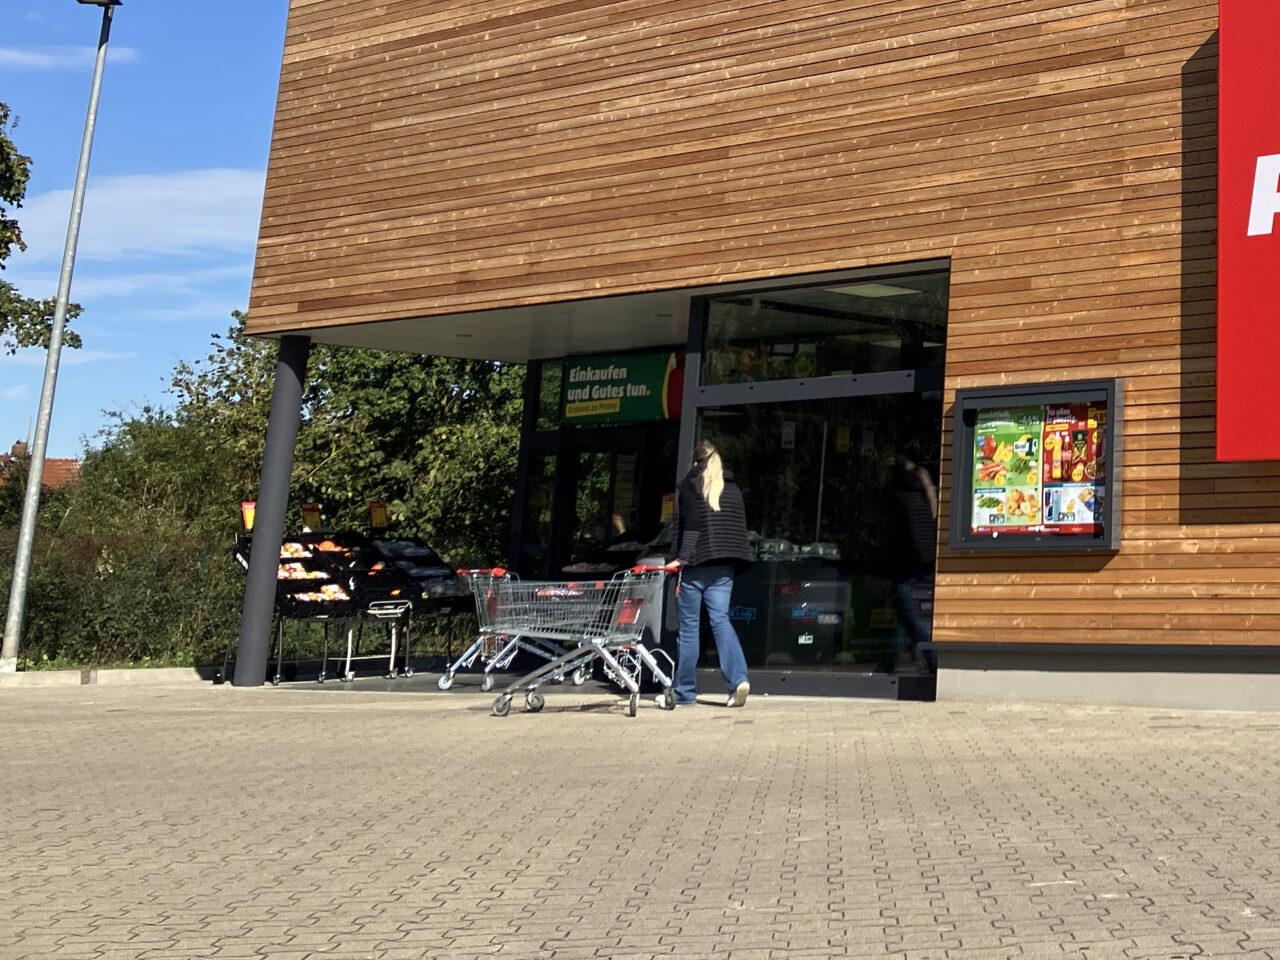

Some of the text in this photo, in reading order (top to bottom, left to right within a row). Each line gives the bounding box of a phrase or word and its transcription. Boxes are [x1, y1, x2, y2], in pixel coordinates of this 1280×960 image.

[568, 365, 628, 382] Einkaufen
[567, 382, 651, 401] und Gutes tun.
